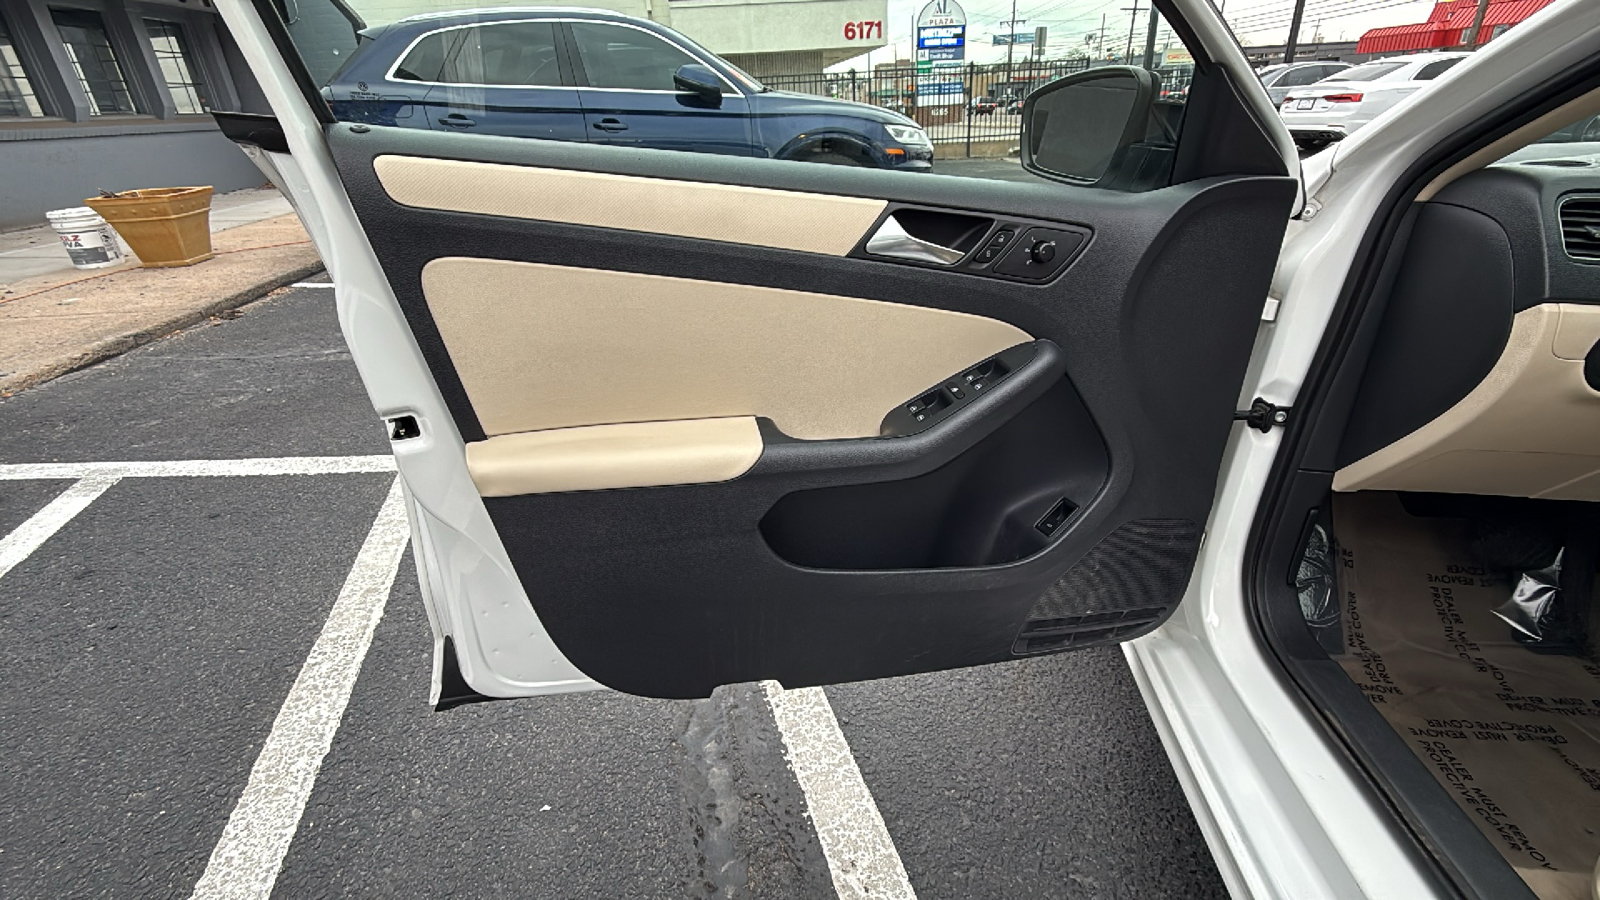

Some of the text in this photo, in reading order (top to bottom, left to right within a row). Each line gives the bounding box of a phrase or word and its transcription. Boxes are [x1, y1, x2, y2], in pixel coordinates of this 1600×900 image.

[929, 18, 954, 26] PLAZA
[844, 20, 882, 40] 6171
[1427, 719, 1474, 730] COVER
[1408, 727, 1468, 739] REMOVE
[1472, 731, 1509, 742] MUST
[1433, 741, 1474, 781] DEALER
[1471, 787, 1508, 818] MUST
[1418, 740, 1523, 851] PROTECTIVE COVER
